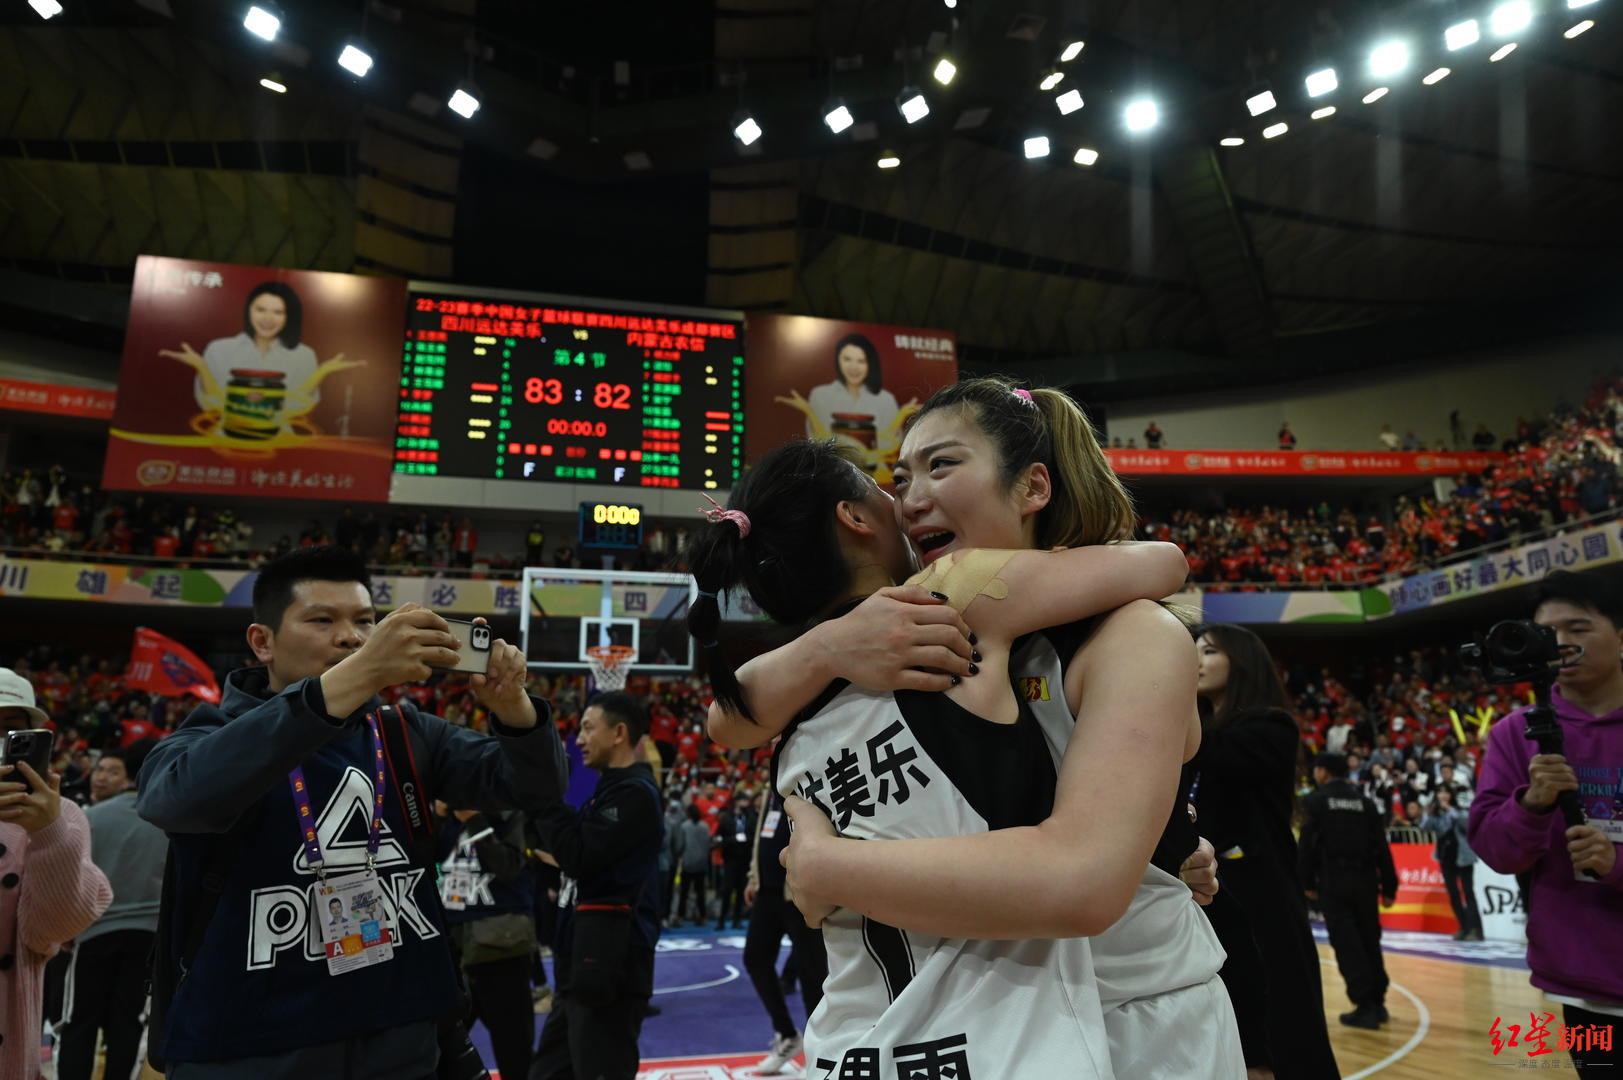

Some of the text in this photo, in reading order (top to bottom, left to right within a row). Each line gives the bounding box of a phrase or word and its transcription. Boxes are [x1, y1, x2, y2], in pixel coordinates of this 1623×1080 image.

[524, 377, 563, 404] 83
[593, 382, 631, 410] 82
[547, 418, 607, 437] 00:00.0
[523, 462, 535, 477] F
[614, 467, 625, 482] F
[402, 782, 421, 827] Canon
[333, 942, 344, 956] A
